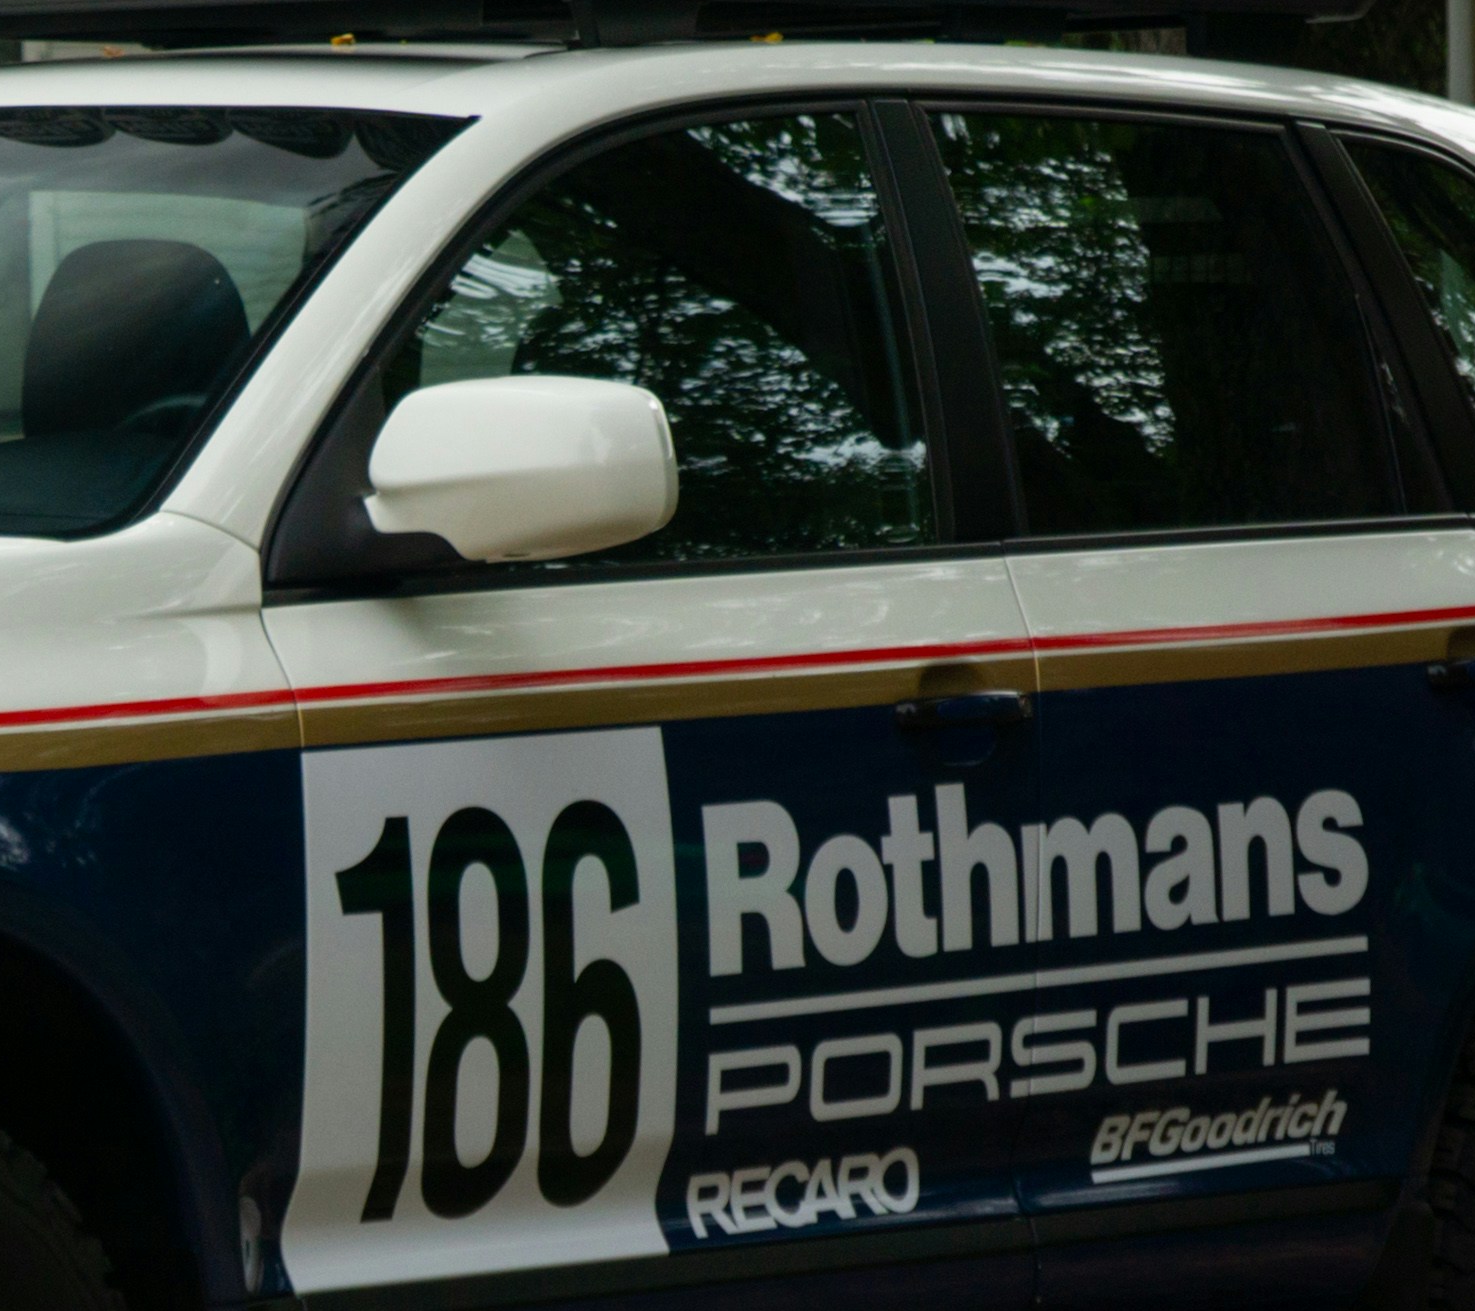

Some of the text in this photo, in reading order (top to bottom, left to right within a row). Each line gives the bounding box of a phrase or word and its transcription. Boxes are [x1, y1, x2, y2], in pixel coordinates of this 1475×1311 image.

[701, 782, 1369, 977] Rothmans
[334, 798, 643, 1225] 186
[704, 977, 1370, 1135] PORSCHE
[1090, 1088, 1348, 1166] BFGoodrich
[1309, 1137, 1336, 1157] Tires
[686, 1146, 919, 1239] RECARO
